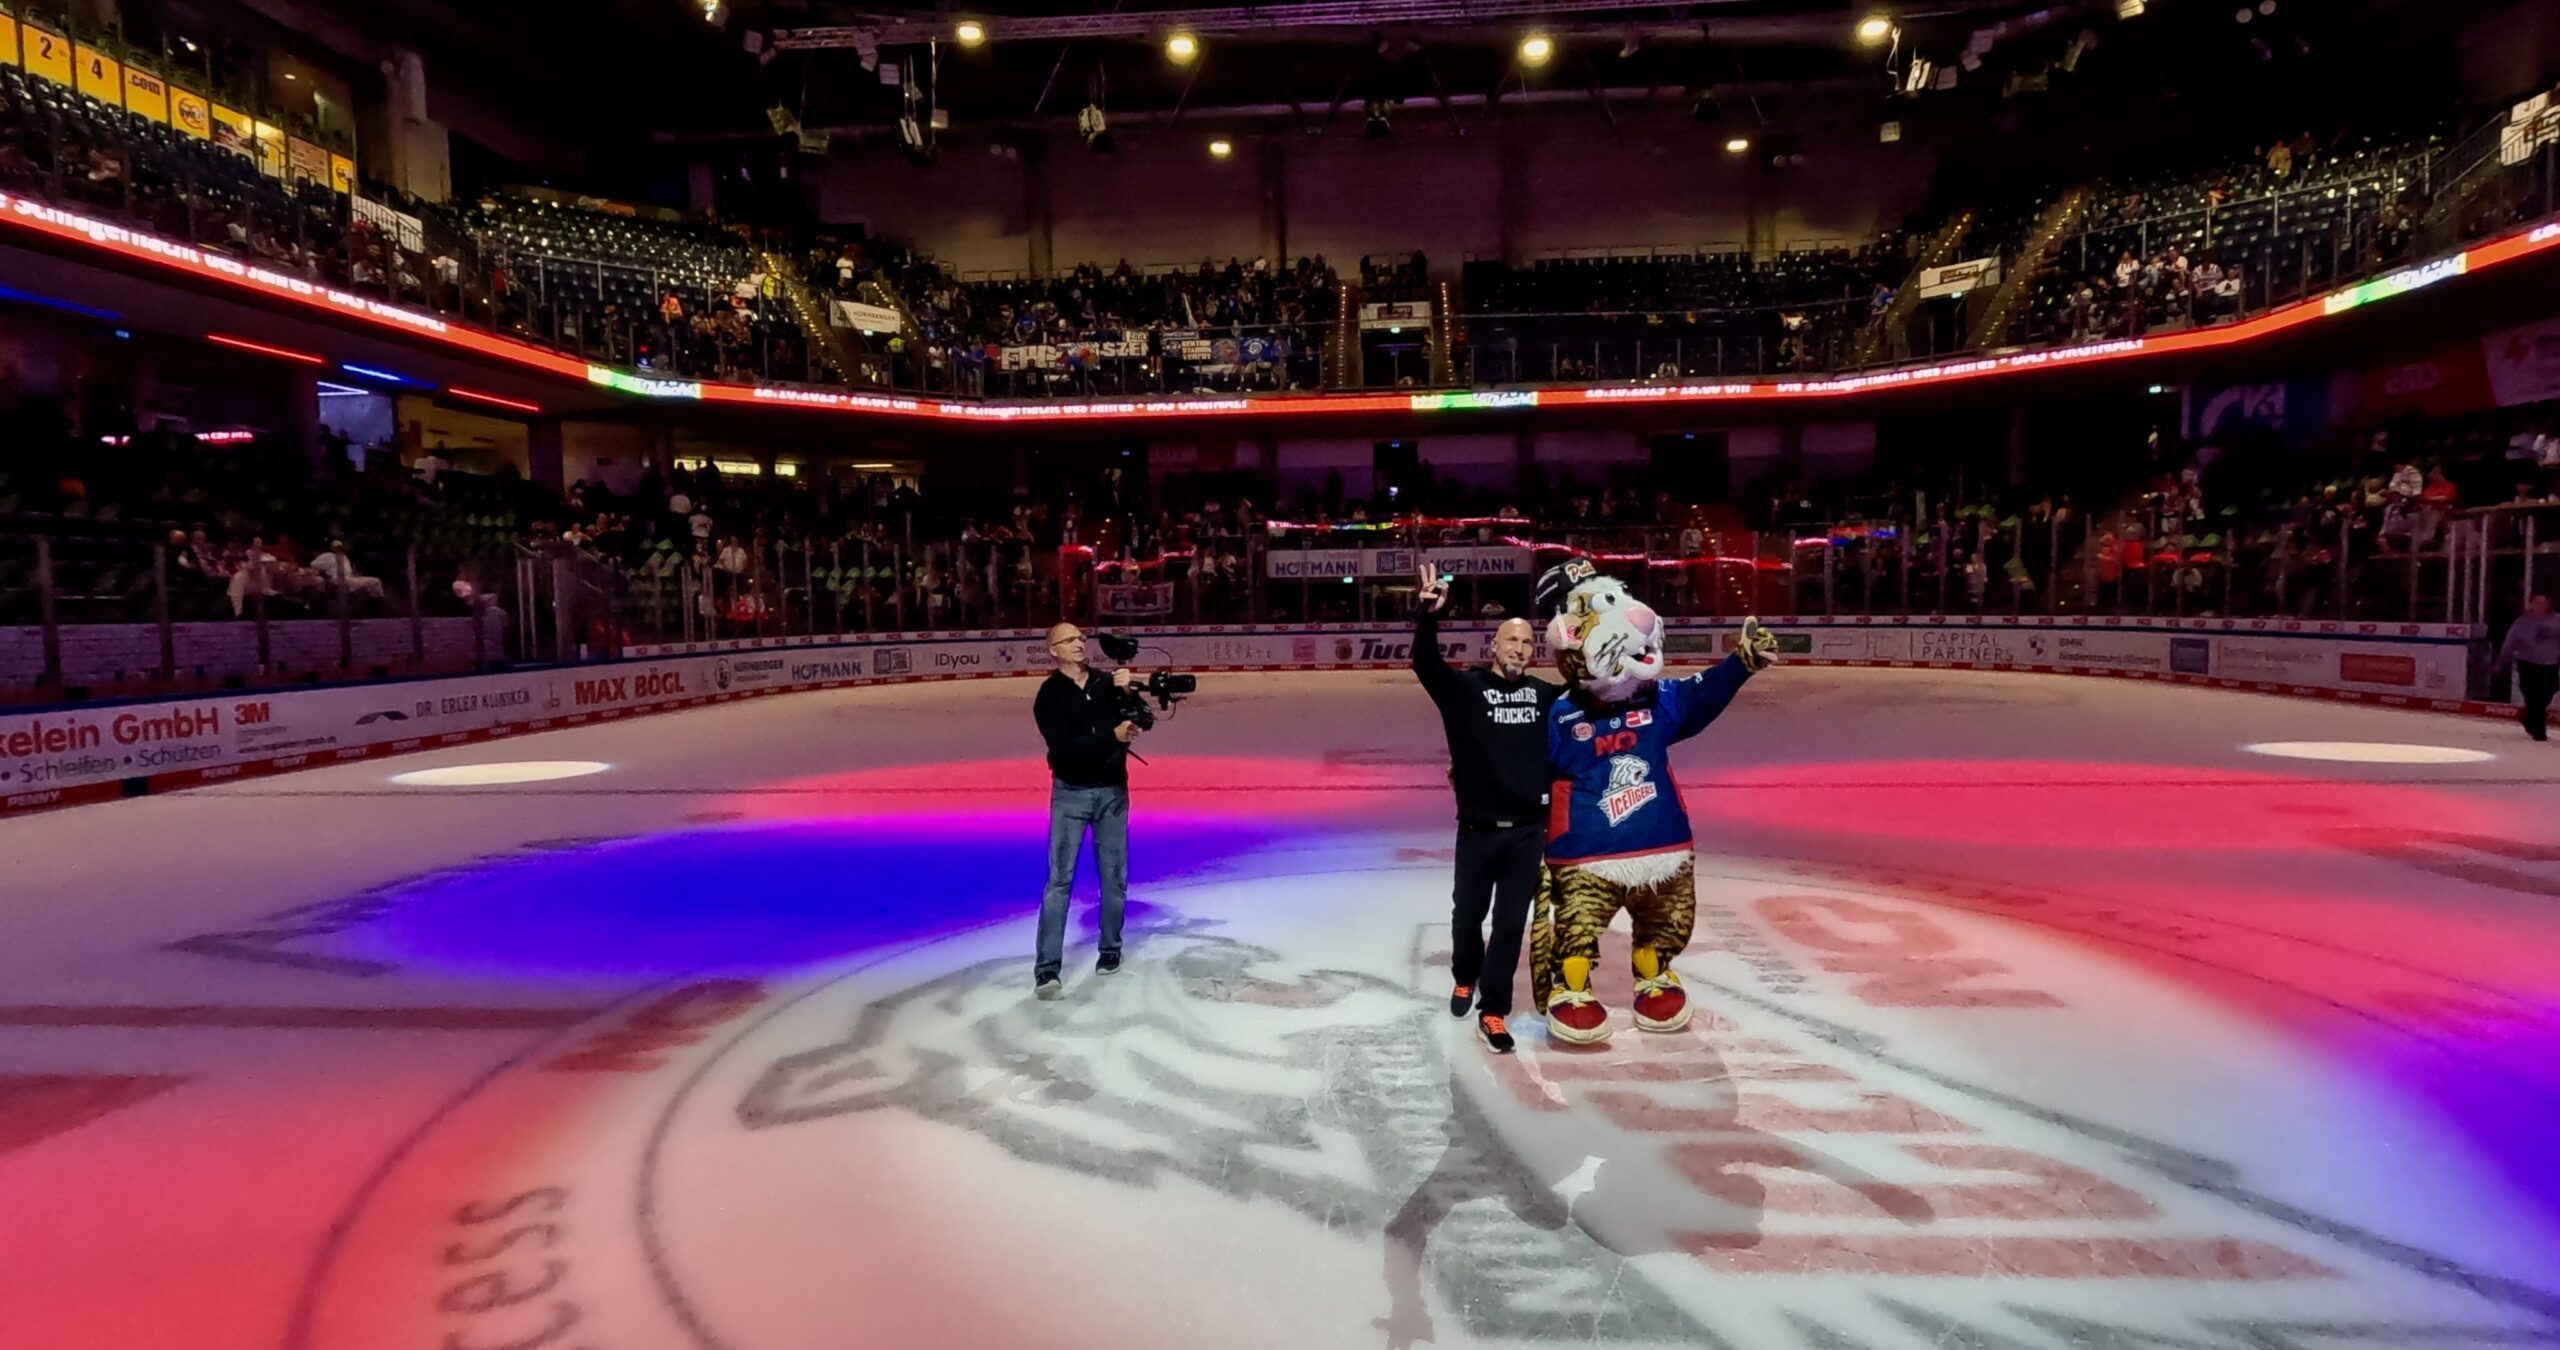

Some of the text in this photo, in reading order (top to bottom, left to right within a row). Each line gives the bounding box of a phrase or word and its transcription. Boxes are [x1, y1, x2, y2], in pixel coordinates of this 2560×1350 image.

[39, 36, 53, 60] 2
[92, 57, 104, 81] 4
[1359, 638, 1467, 660] Tucer
[1922, 630, 2000, 646] CAPITAL
[934, 653, 981, 669] IDyou
[1922, 647, 2014, 662] PARTNERS
[791, 661, 862, 681] HOFMANN
[575, 667, 686, 706] MAX BÖGL
[234, 702, 270, 726] 3M
[415, 701, 437, 718] DR.
[441, 694, 478, 714] ERLER
[1493, 706, 1536, 724] HOCKEY
[112, 706, 220, 745] GmbH
[20, 754, 117, 784] Schleifen
